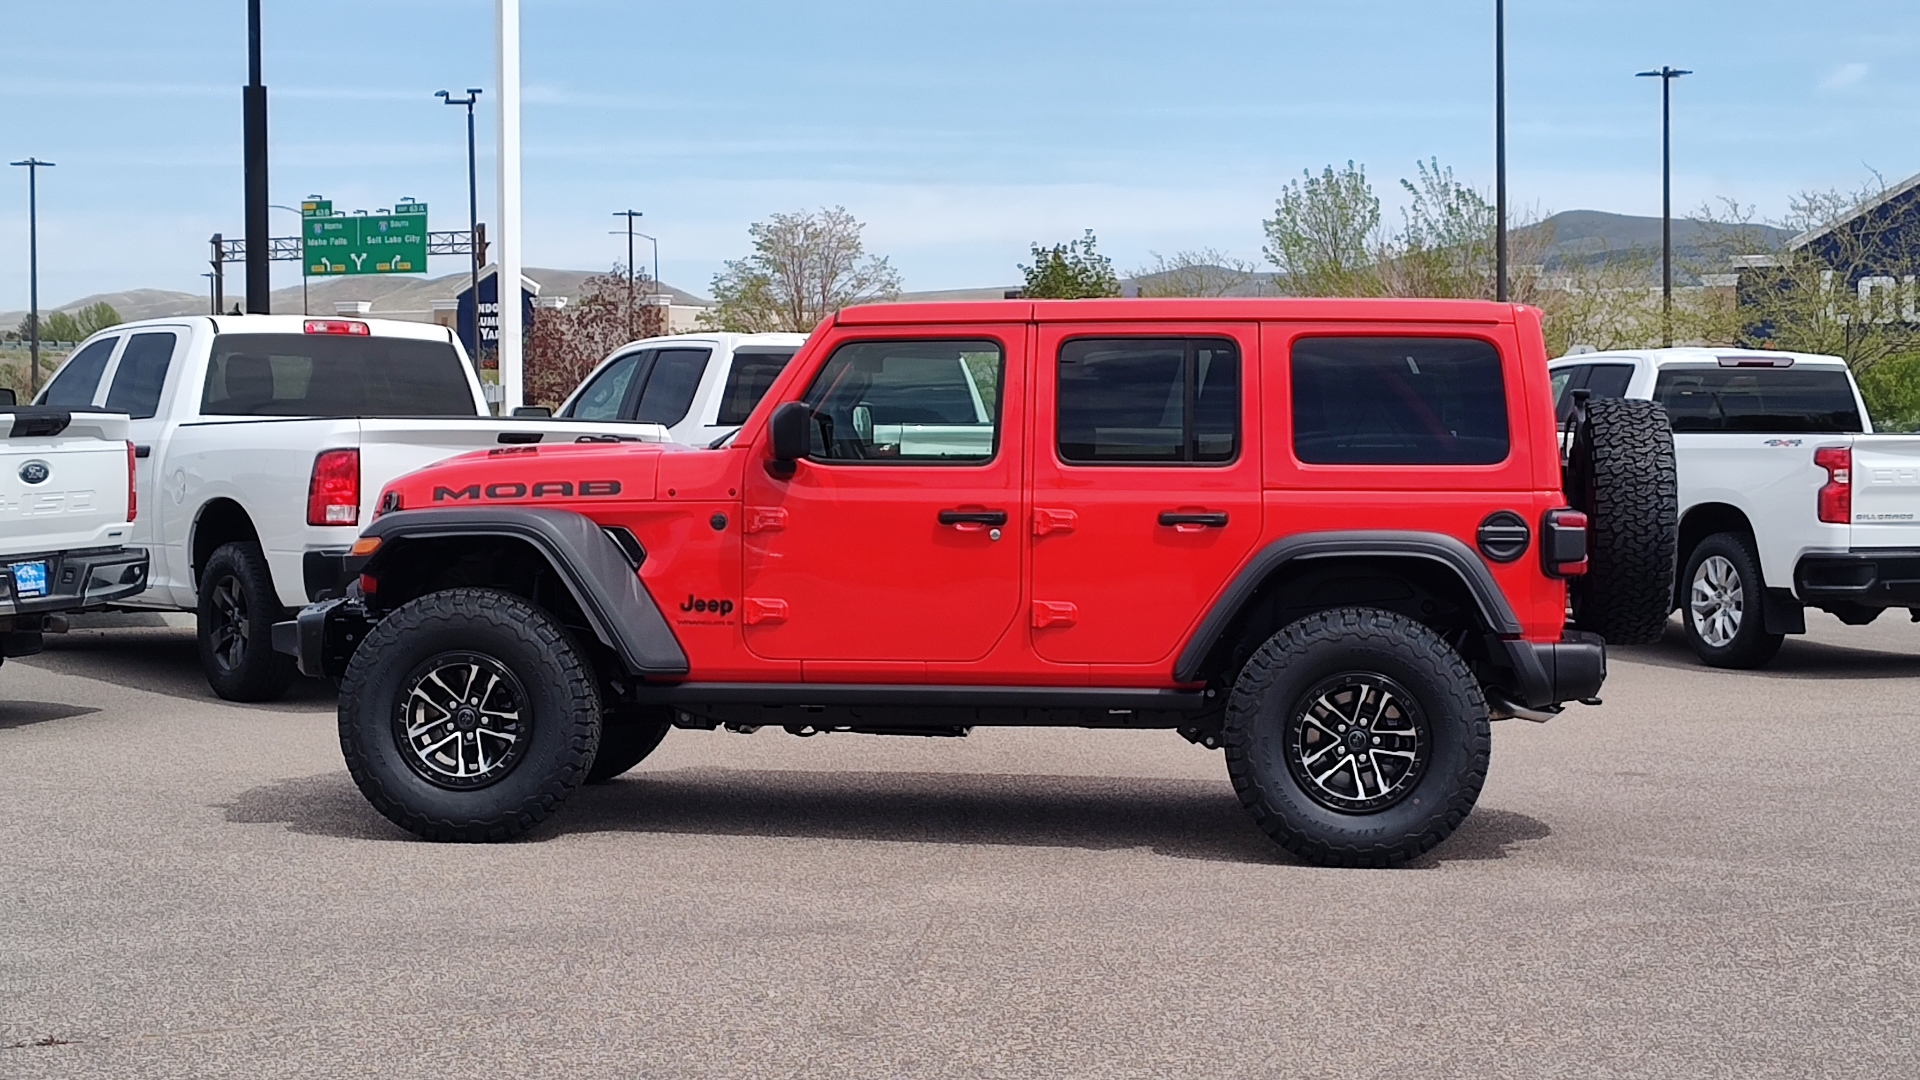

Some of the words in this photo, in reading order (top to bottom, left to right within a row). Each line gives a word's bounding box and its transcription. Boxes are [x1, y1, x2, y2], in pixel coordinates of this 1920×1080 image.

[307, 238, 328, 246] Idaho
[329, 237, 348, 246] Falls
[367, 236, 382, 244] Salt
[384, 236, 402, 244] Lake
[404, 235, 421, 244] City
[478, 317, 498, 327] UM
[433, 480, 622, 501] MOAB
[679, 594, 734, 617] Jeep
